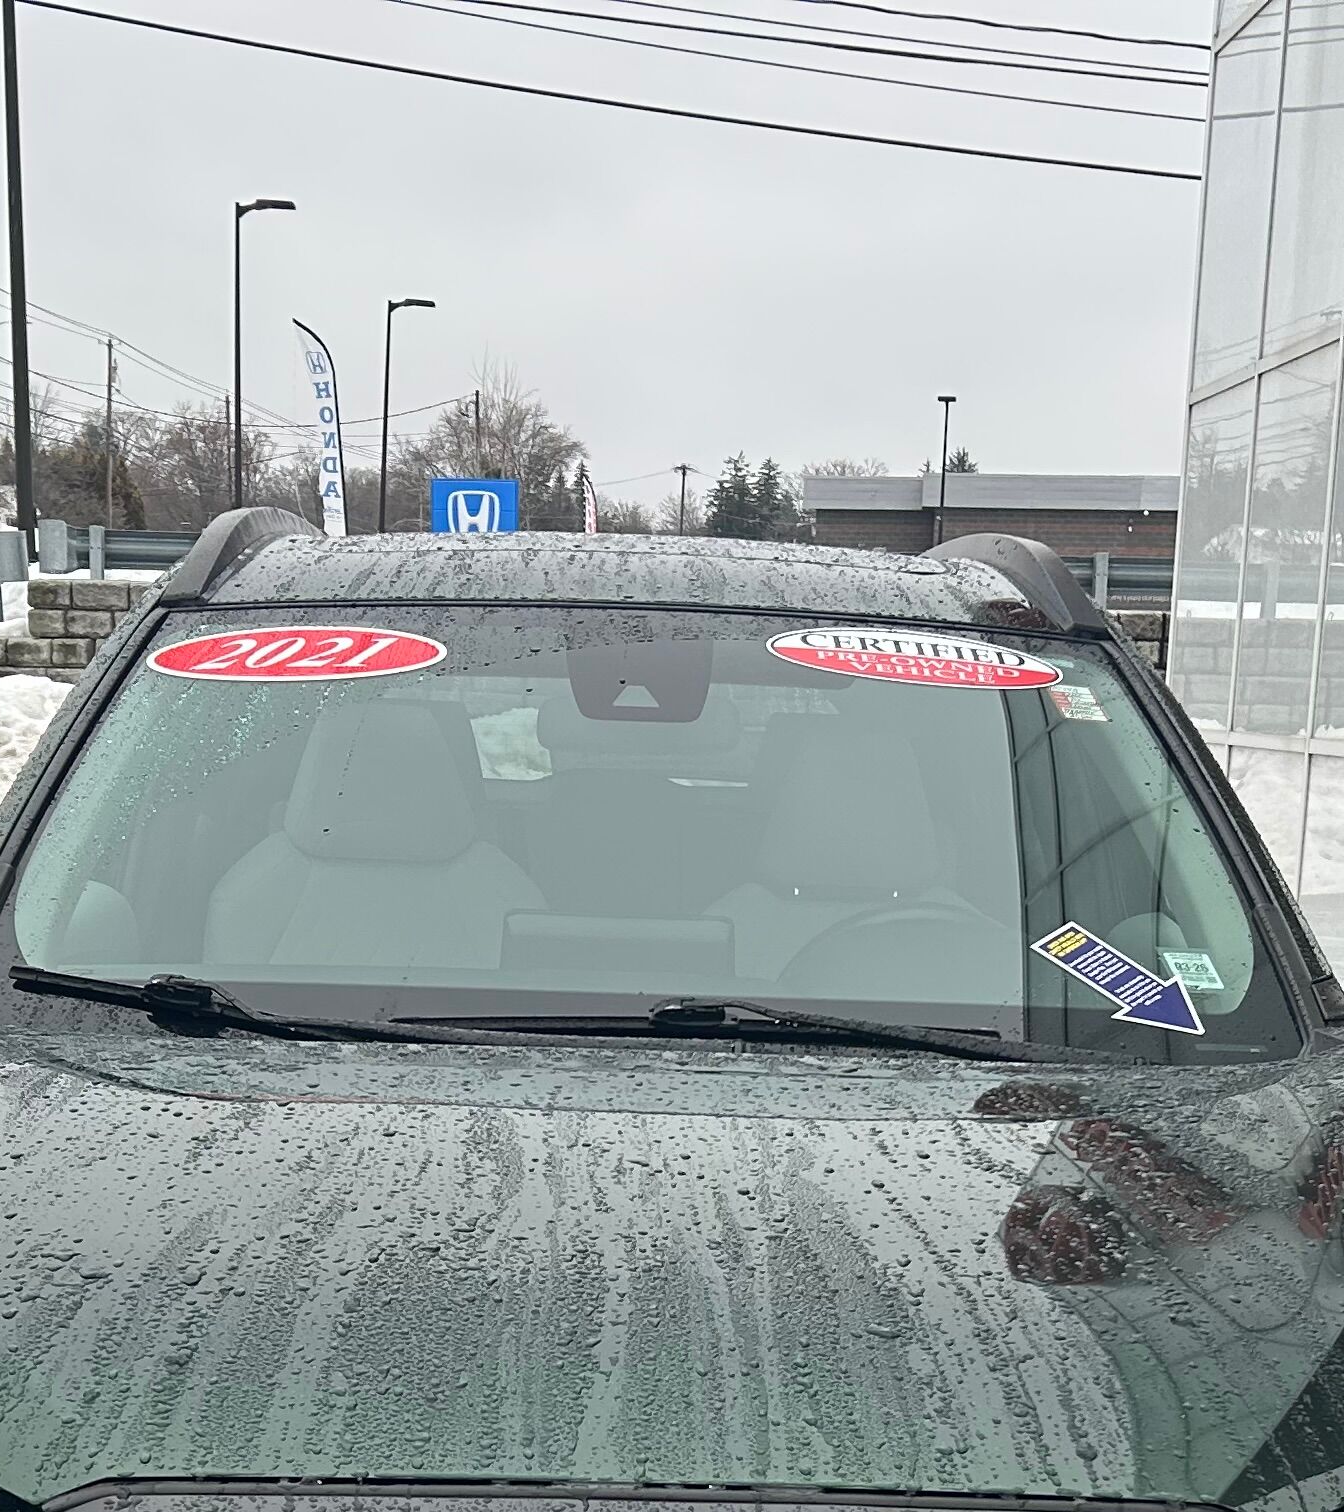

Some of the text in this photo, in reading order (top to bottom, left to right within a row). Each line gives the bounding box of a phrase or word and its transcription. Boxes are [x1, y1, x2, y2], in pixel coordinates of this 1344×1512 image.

[189, 636, 400, 671] 2021
[799, 633, 1026, 667] CERTIFIED
[815, 650, 1021, 678] PRE-OWNED
[847, 661, 996, 685] VEHICLE
